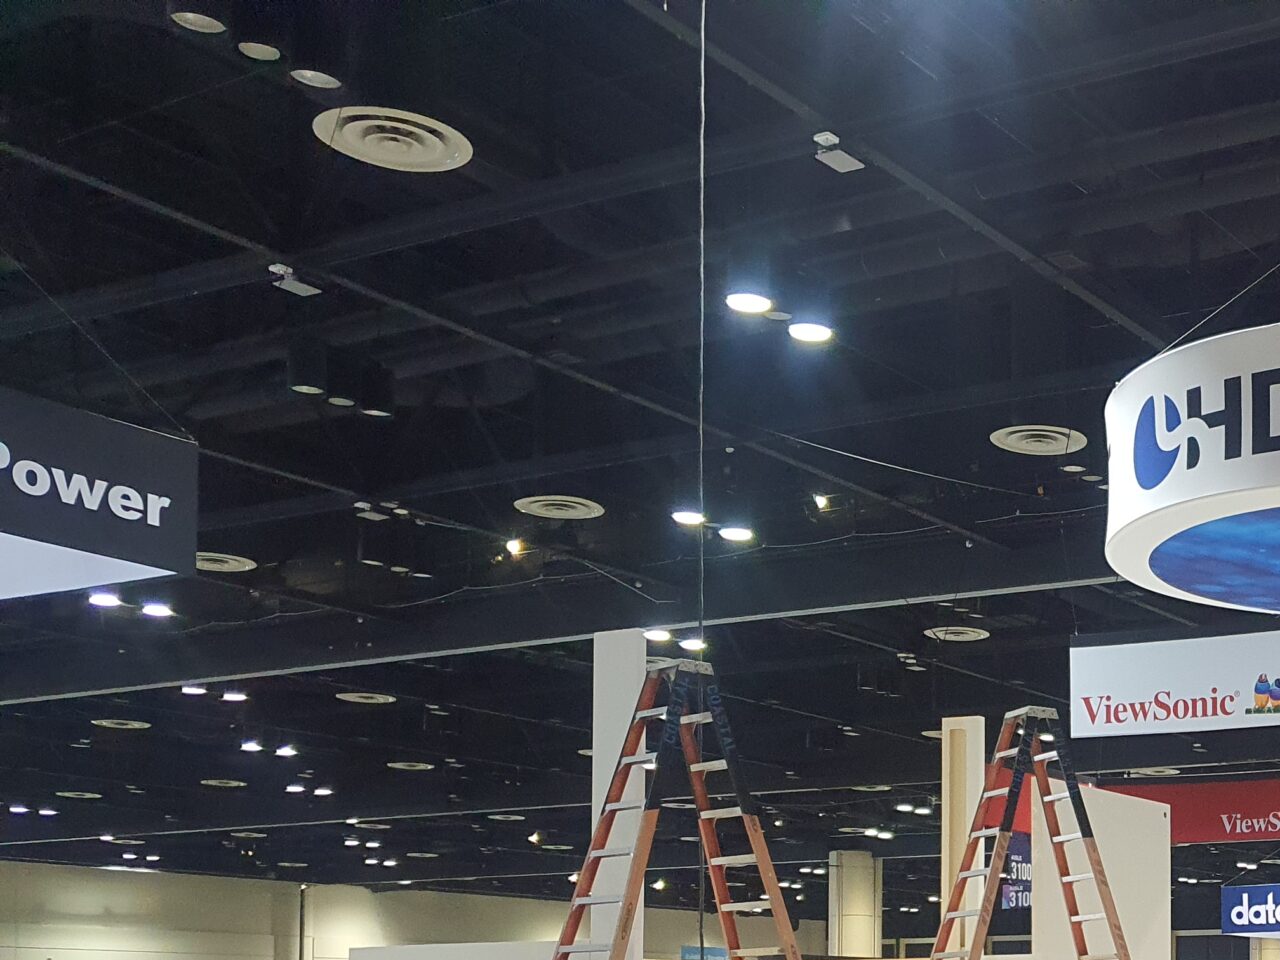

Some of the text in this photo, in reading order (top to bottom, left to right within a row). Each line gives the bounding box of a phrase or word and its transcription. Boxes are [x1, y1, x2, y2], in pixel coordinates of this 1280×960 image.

[1081, 687, 1235, 726] ViewSonic
[1011, 862, 1032, 880] 3100
[1009, 891, 1032, 907] 310
